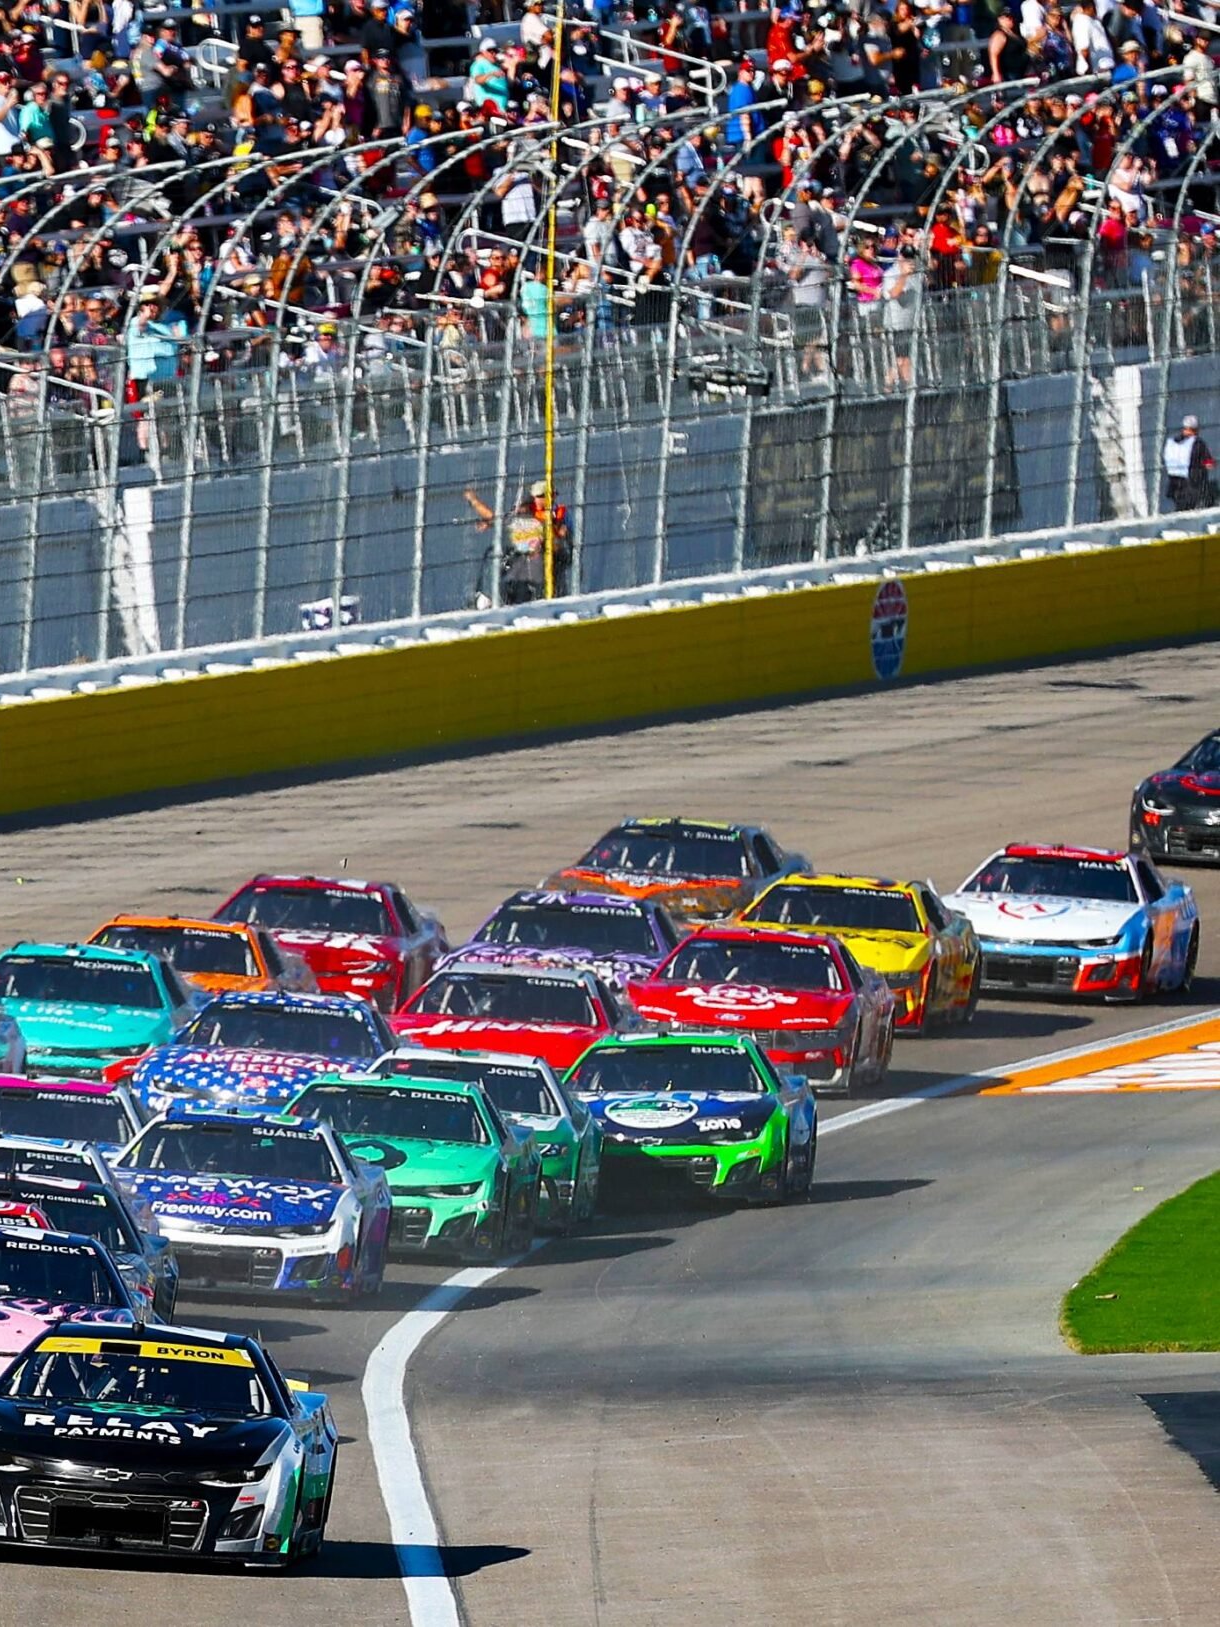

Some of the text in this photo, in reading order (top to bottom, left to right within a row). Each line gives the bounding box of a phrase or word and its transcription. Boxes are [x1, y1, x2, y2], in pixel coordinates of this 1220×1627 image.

[690, 1046, 746, 1055] BUSCH
[179, 1051, 352, 1074] AMERICAN
[229, 1062, 295, 1076] BEER
[486, 1067, 538, 1079] JONES
[388, 1089, 468, 1104] A. DILLON
[26, 1151, 83, 1163] PREECE
[20, 1191, 102, 1207] VAN GISBERGE
[150, 1200, 273, 1222] Freeway.com
[5, 1240, 82, 1256] REDDICK
[156, 1344, 226, 1361] BYRON
[22, 1412, 220, 1440] RELAY
[53, 1426, 183, 1446] PAYMENTS
